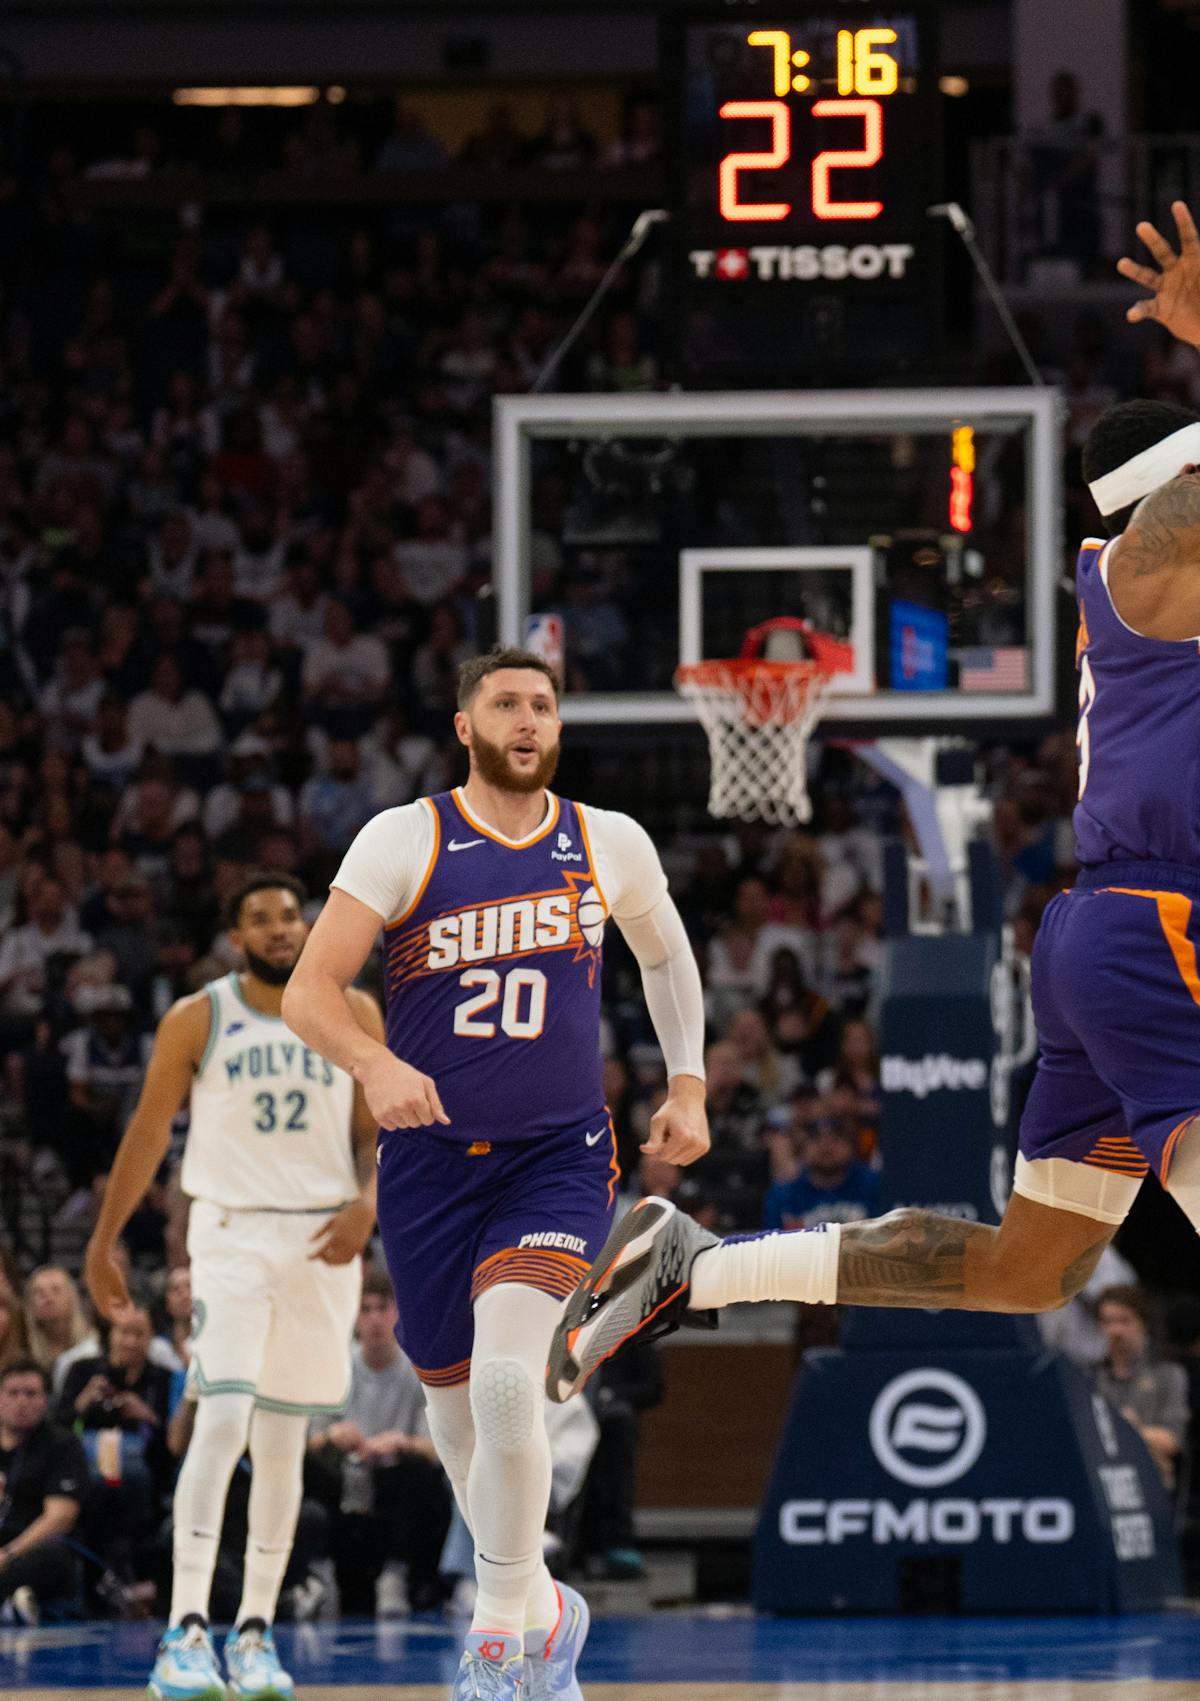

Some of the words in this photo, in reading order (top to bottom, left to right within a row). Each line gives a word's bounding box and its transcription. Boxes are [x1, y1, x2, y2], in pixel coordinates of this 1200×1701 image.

[748, 28, 898, 97] 7:16
[719, 99, 885, 221] 22
[749, 243, 915, 281] TISSOT
[551, 850, 582, 862] PayPal
[427, 895, 571, 970] SUNS
[453, 967, 547, 1041] 20
[255, 1089, 309, 1133] 32
[518, 1230, 588, 1256] PHOENIX
[778, 1497, 1075, 1546] CFMOTO
